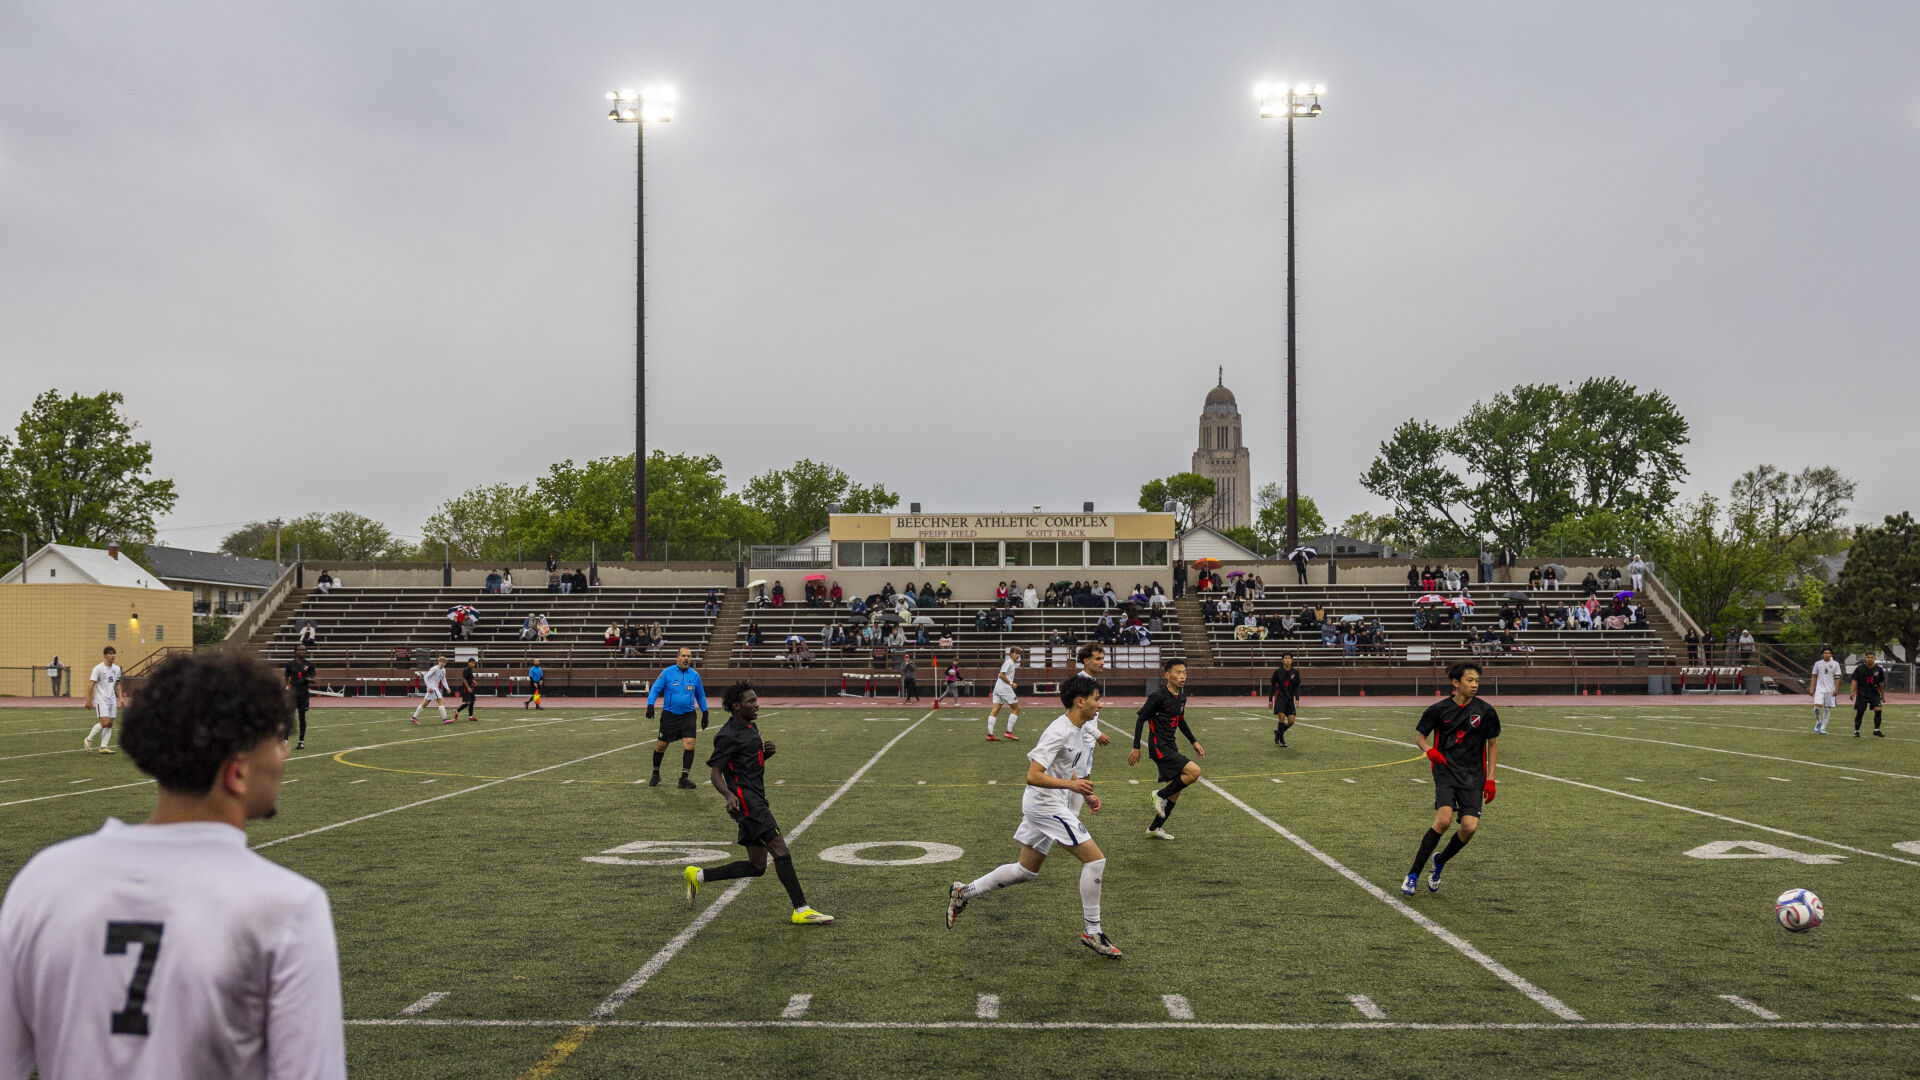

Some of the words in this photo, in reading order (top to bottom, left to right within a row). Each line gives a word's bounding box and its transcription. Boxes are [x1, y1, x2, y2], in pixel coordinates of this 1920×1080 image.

[897, 517, 968, 528] BEECHNER
[974, 517, 1039, 528] ATHLETIC
[1044, 516, 1108, 527] COMPLEX
[951, 530, 977, 538] FIELD
[1056, 529, 1086, 537] TRACK
[103, 921, 164, 1036] 7
